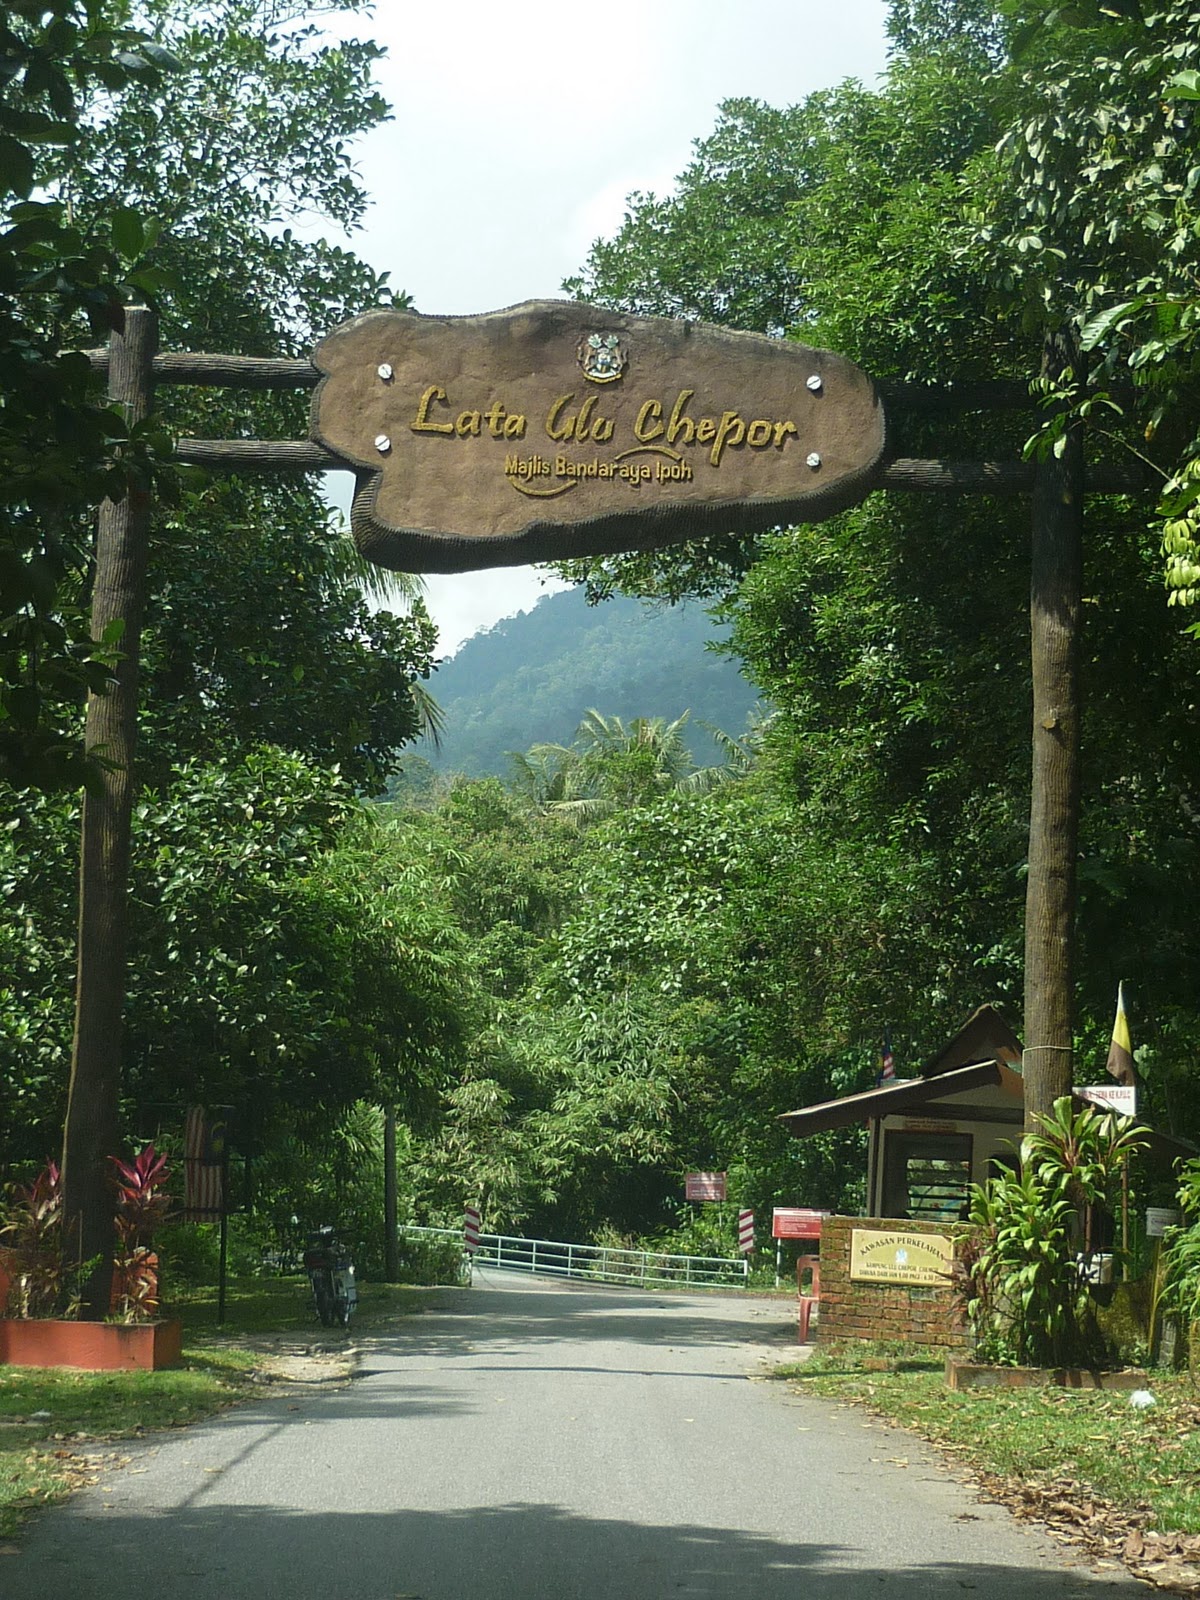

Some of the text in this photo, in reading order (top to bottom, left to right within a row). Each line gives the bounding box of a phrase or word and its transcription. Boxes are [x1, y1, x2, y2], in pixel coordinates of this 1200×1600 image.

[411, 385, 798, 467] Lata Ulu Chepor
[504, 454, 693, 485] Majlis Bandaraya Ipoh
[860, 1237, 895, 1256] KAWASAN
